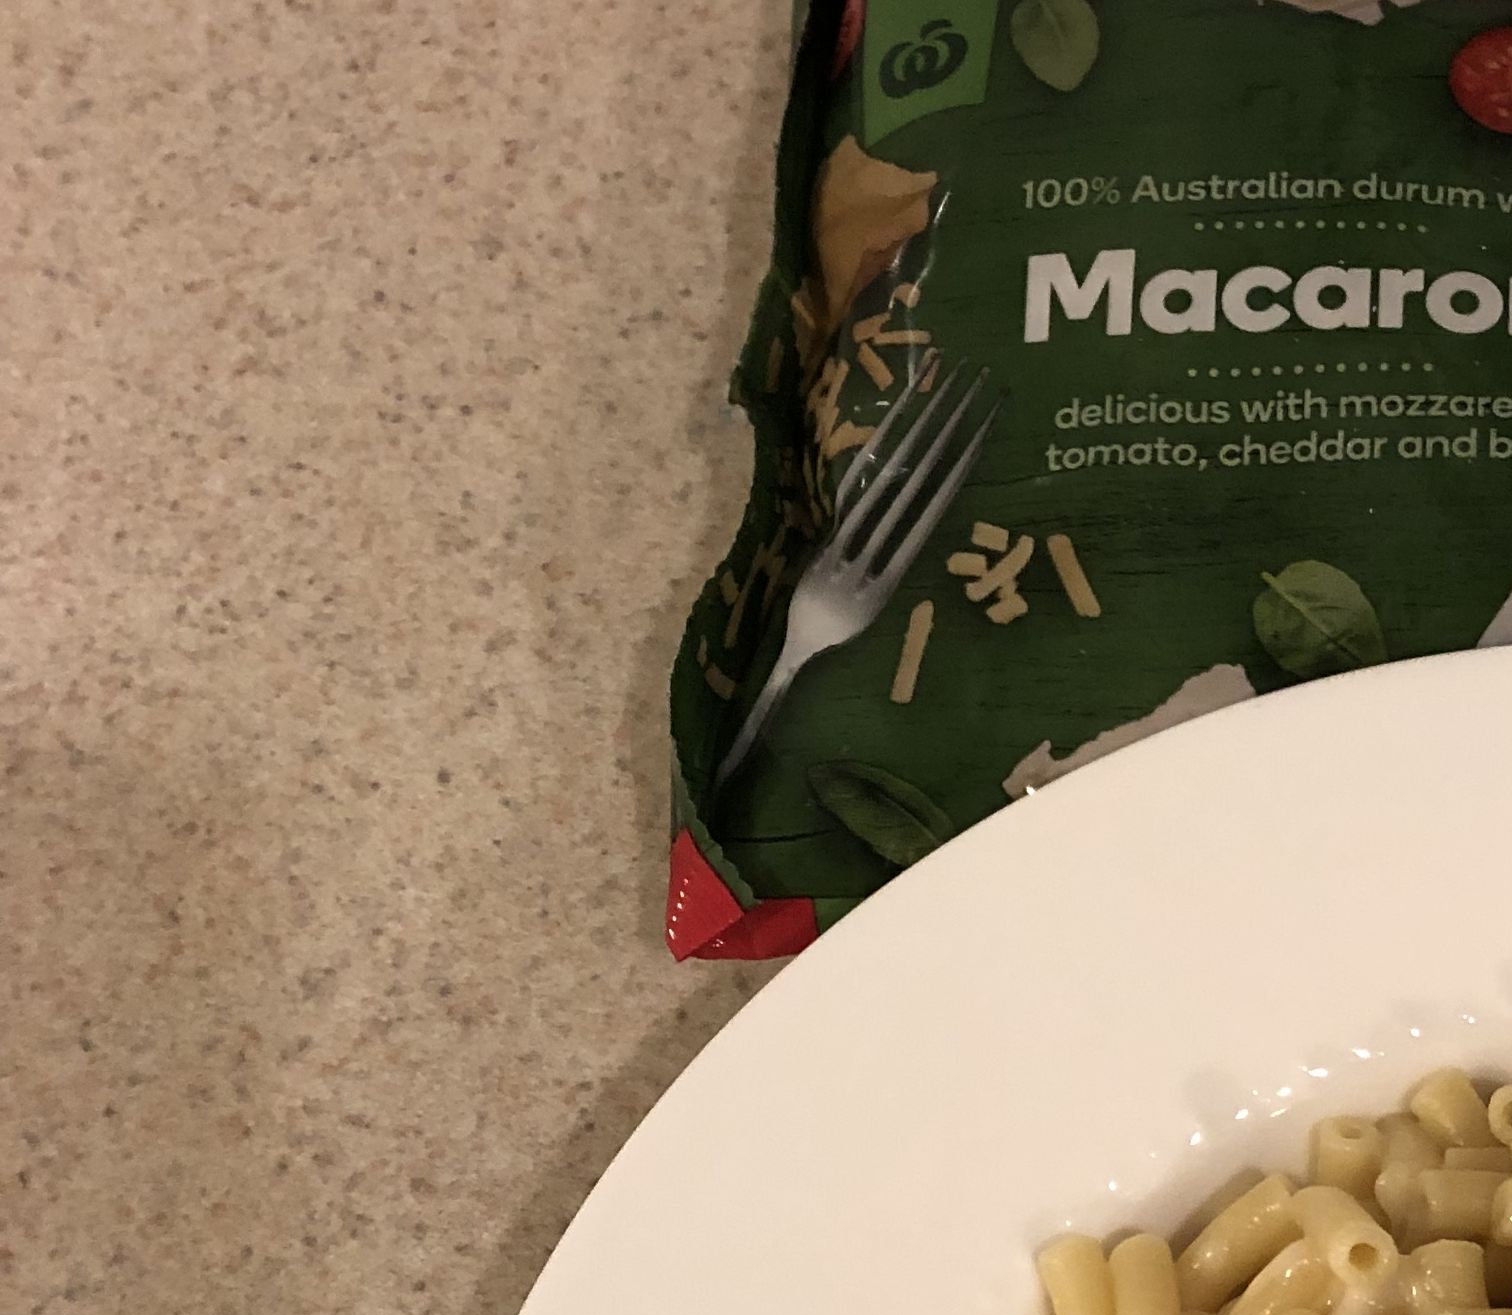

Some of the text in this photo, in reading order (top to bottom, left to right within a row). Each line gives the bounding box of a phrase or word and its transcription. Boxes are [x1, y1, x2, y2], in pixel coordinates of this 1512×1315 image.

[1022, 177, 1121, 209] 100%
[1130, 172, 1343, 203] Australian
[1352, 172, 1486, 209] durum
[1054, 393, 1231, 430] delicious
[1240, 388, 1328, 423] with
[1045, 436, 1208, 472] tomato,
[1219, 430, 1388, 467] cheddar
[1398, 427, 1478, 459] and
